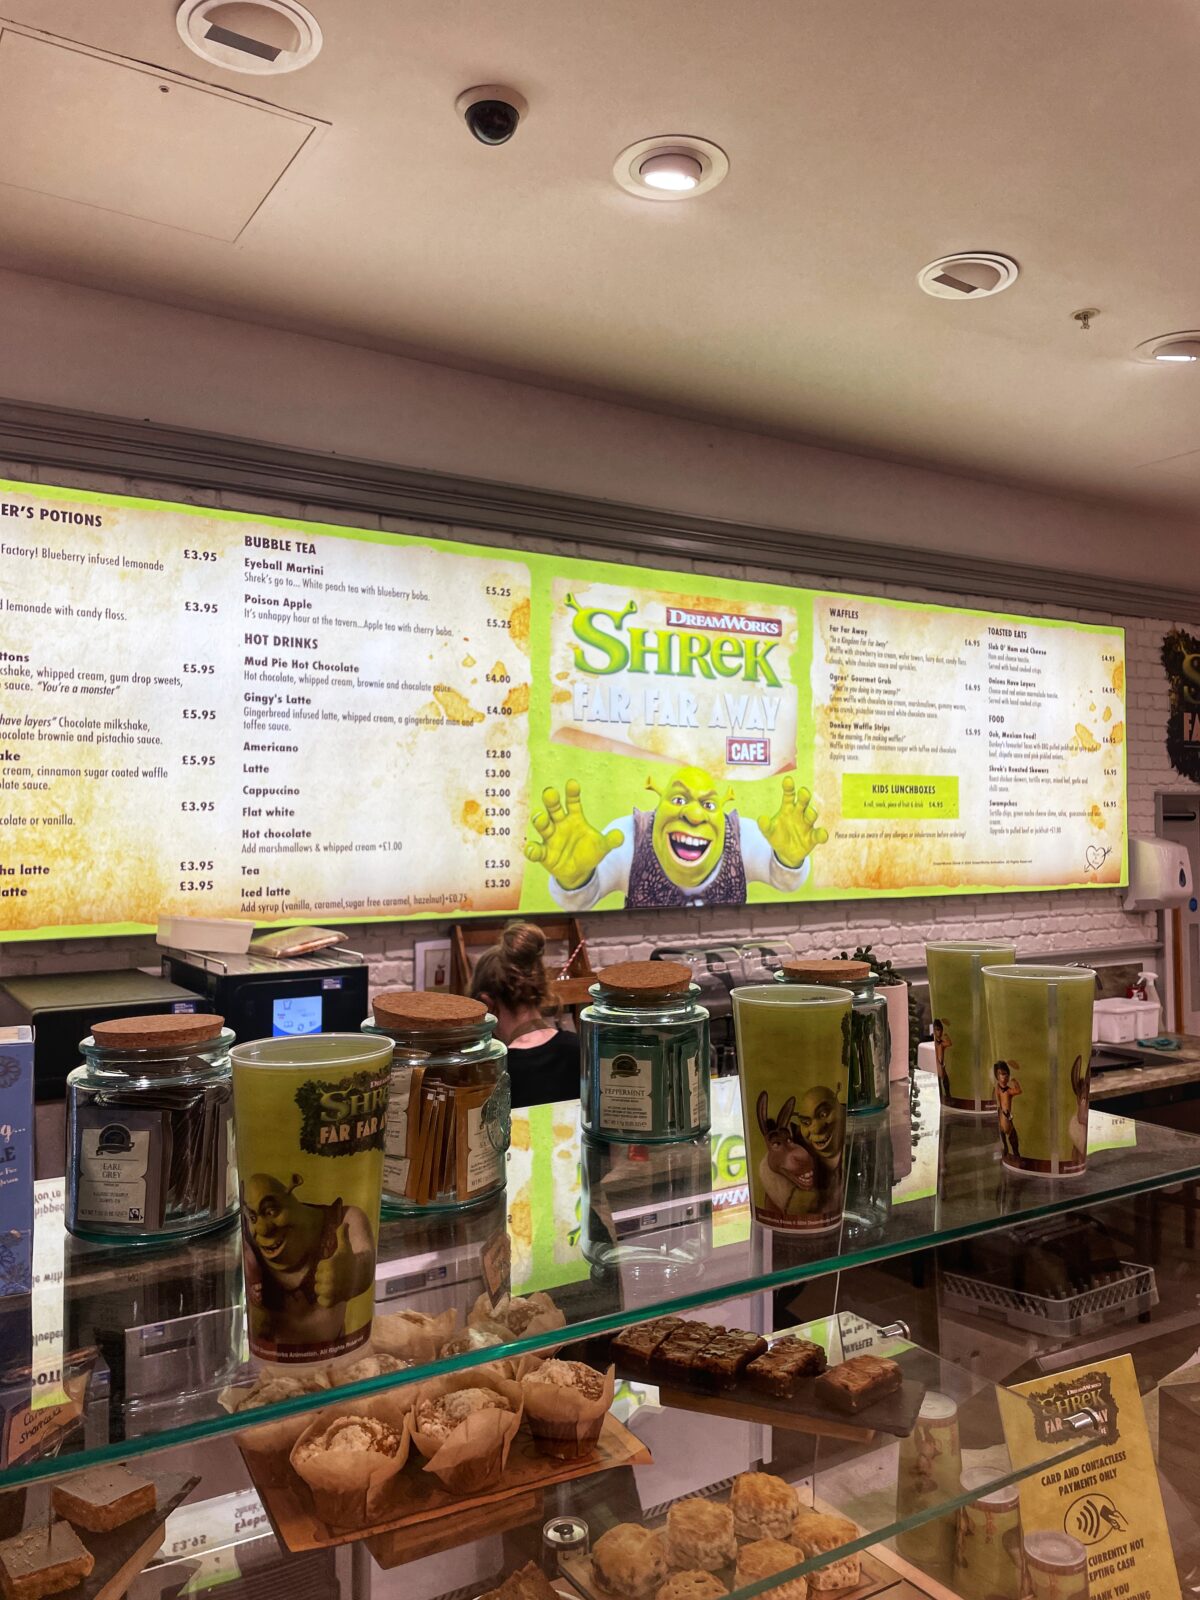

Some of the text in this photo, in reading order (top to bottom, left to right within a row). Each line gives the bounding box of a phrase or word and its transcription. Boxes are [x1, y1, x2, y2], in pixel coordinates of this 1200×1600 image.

[40, 508, 101, 526] POTIONS
[244, 535, 316, 554] BUBBLE TEA
[1, 543, 163, 571] Factory! Blueberry infused lemonade
[184, 549, 216, 561] £3.95
[244, 557, 323, 575] Eyeball Martini
[244, 571, 272, 584] Shrek's
[274, 578, 283, 587] go
[302, 578, 322, 589] White
[325, 581, 345, 592] peach
[348, 584, 358, 593] tea
[360, 585, 375, 595] with
[377, 586, 410, 600] blueberry
[486, 586, 510, 596] £5.25
[185, 601, 217, 613] £3.95
[244, 594, 312, 610] Poison Apple
[6, 599, 51, 614] lemonade
[54, 604, 73, 616] with
[76, 607, 102, 620] candy
[829, 608, 858, 619] WAFFLES
[486, 618, 512, 628] £5.25
[670, 609, 778, 634] DREAMWORKS
[988, 627, 1026, 638] TOASTED EATS
[244, 633, 317, 649] HOT DRINKS
[564, 592, 782, 687] SHREK
[183, 663, 214, 674] £5.95
[244, 656, 358, 672] Mud Pie Hot Chocolate
[36, 666, 74, 680] whipped
[110, 674, 128, 684] gum
[132, 672, 151, 686] drop
[485, 673, 510, 683] £4.00
[244, 692, 311, 705] Gingy's Latte
[486, 706, 512, 717] £4.00
[573, 683, 631, 724] FAR
[645, 685, 699, 727] FAR
[708, 692, 781, 731] AWAY
[182, 709, 215, 719] £5.95
[988, 714, 1004, 723] FOOD
[58, 716, 100, 728] Chocolate
[38, 730, 74, 741] brownie
[76, 731, 93, 742] and
[96, 732, 134, 744] pistachio
[243, 741, 298, 752] Americano
[732, 742, 765, 761] CAFE
[486, 749, 511, 758] £2.80
[182, 755, 215, 765] £5.95
[37, 765, 80, 776] cinnamon
[84, 769, 108, 779] sugar
[111, 766, 138, 777] coated
[142, 767, 167, 777] waffle
[243, 763, 269, 772] Latte
[485, 769, 510, 777] £3.00
[242, 785, 299, 797] Cappuccino
[485, 788, 510, 797] £3.00
[872, 784, 935, 794] KIDS LUNCHBOXES
[181, 801, 214, 811] £3.95
[242, 806, 294, 816] Flat white
[485, 807, 510, 816] £3.00
[30, 817, 38, 825] or
[242, 828, 311, 838] Hot chocolate
[484, 827, 510, 835] £3.00
[241, 842, 256, 853] Add
[258, 842, 312, 853] marshmallows
[314, 843, 320, 852] &
[322, 841, 353, 853] whipped
[355, 842, 376, 852] cream
[20, 864, 49, 874] latte
[180, 860, 213, 870] £3.95
[485, 859, 510, 868] £2.50
[241, 866, 259, 875] Tea
[180, 880, 213, 890] £3.95
[485, 879, 510, 888] £3.20
[241, 886, 290, 897] Iced latte
[605, 1088, 645, 1096] PEPPERMINT
[320, 1117, 377, 1144] FAR FAR
[1038, 1389, 1107, 1416] SHREK
[1045, 1418, 1063, 1434] FAR
[1042, 1451, 1126, 1486] CARD AND CONTACTLESS
[1059, 1468, 1117, 1496] PAYMENTS ONLY
[1088, 1538, 1144, 1567] CURRENTLY NOT
[1117, 1556, 1135, 1571] CASH
[1114, 1583, 1129, 1596] YOU
